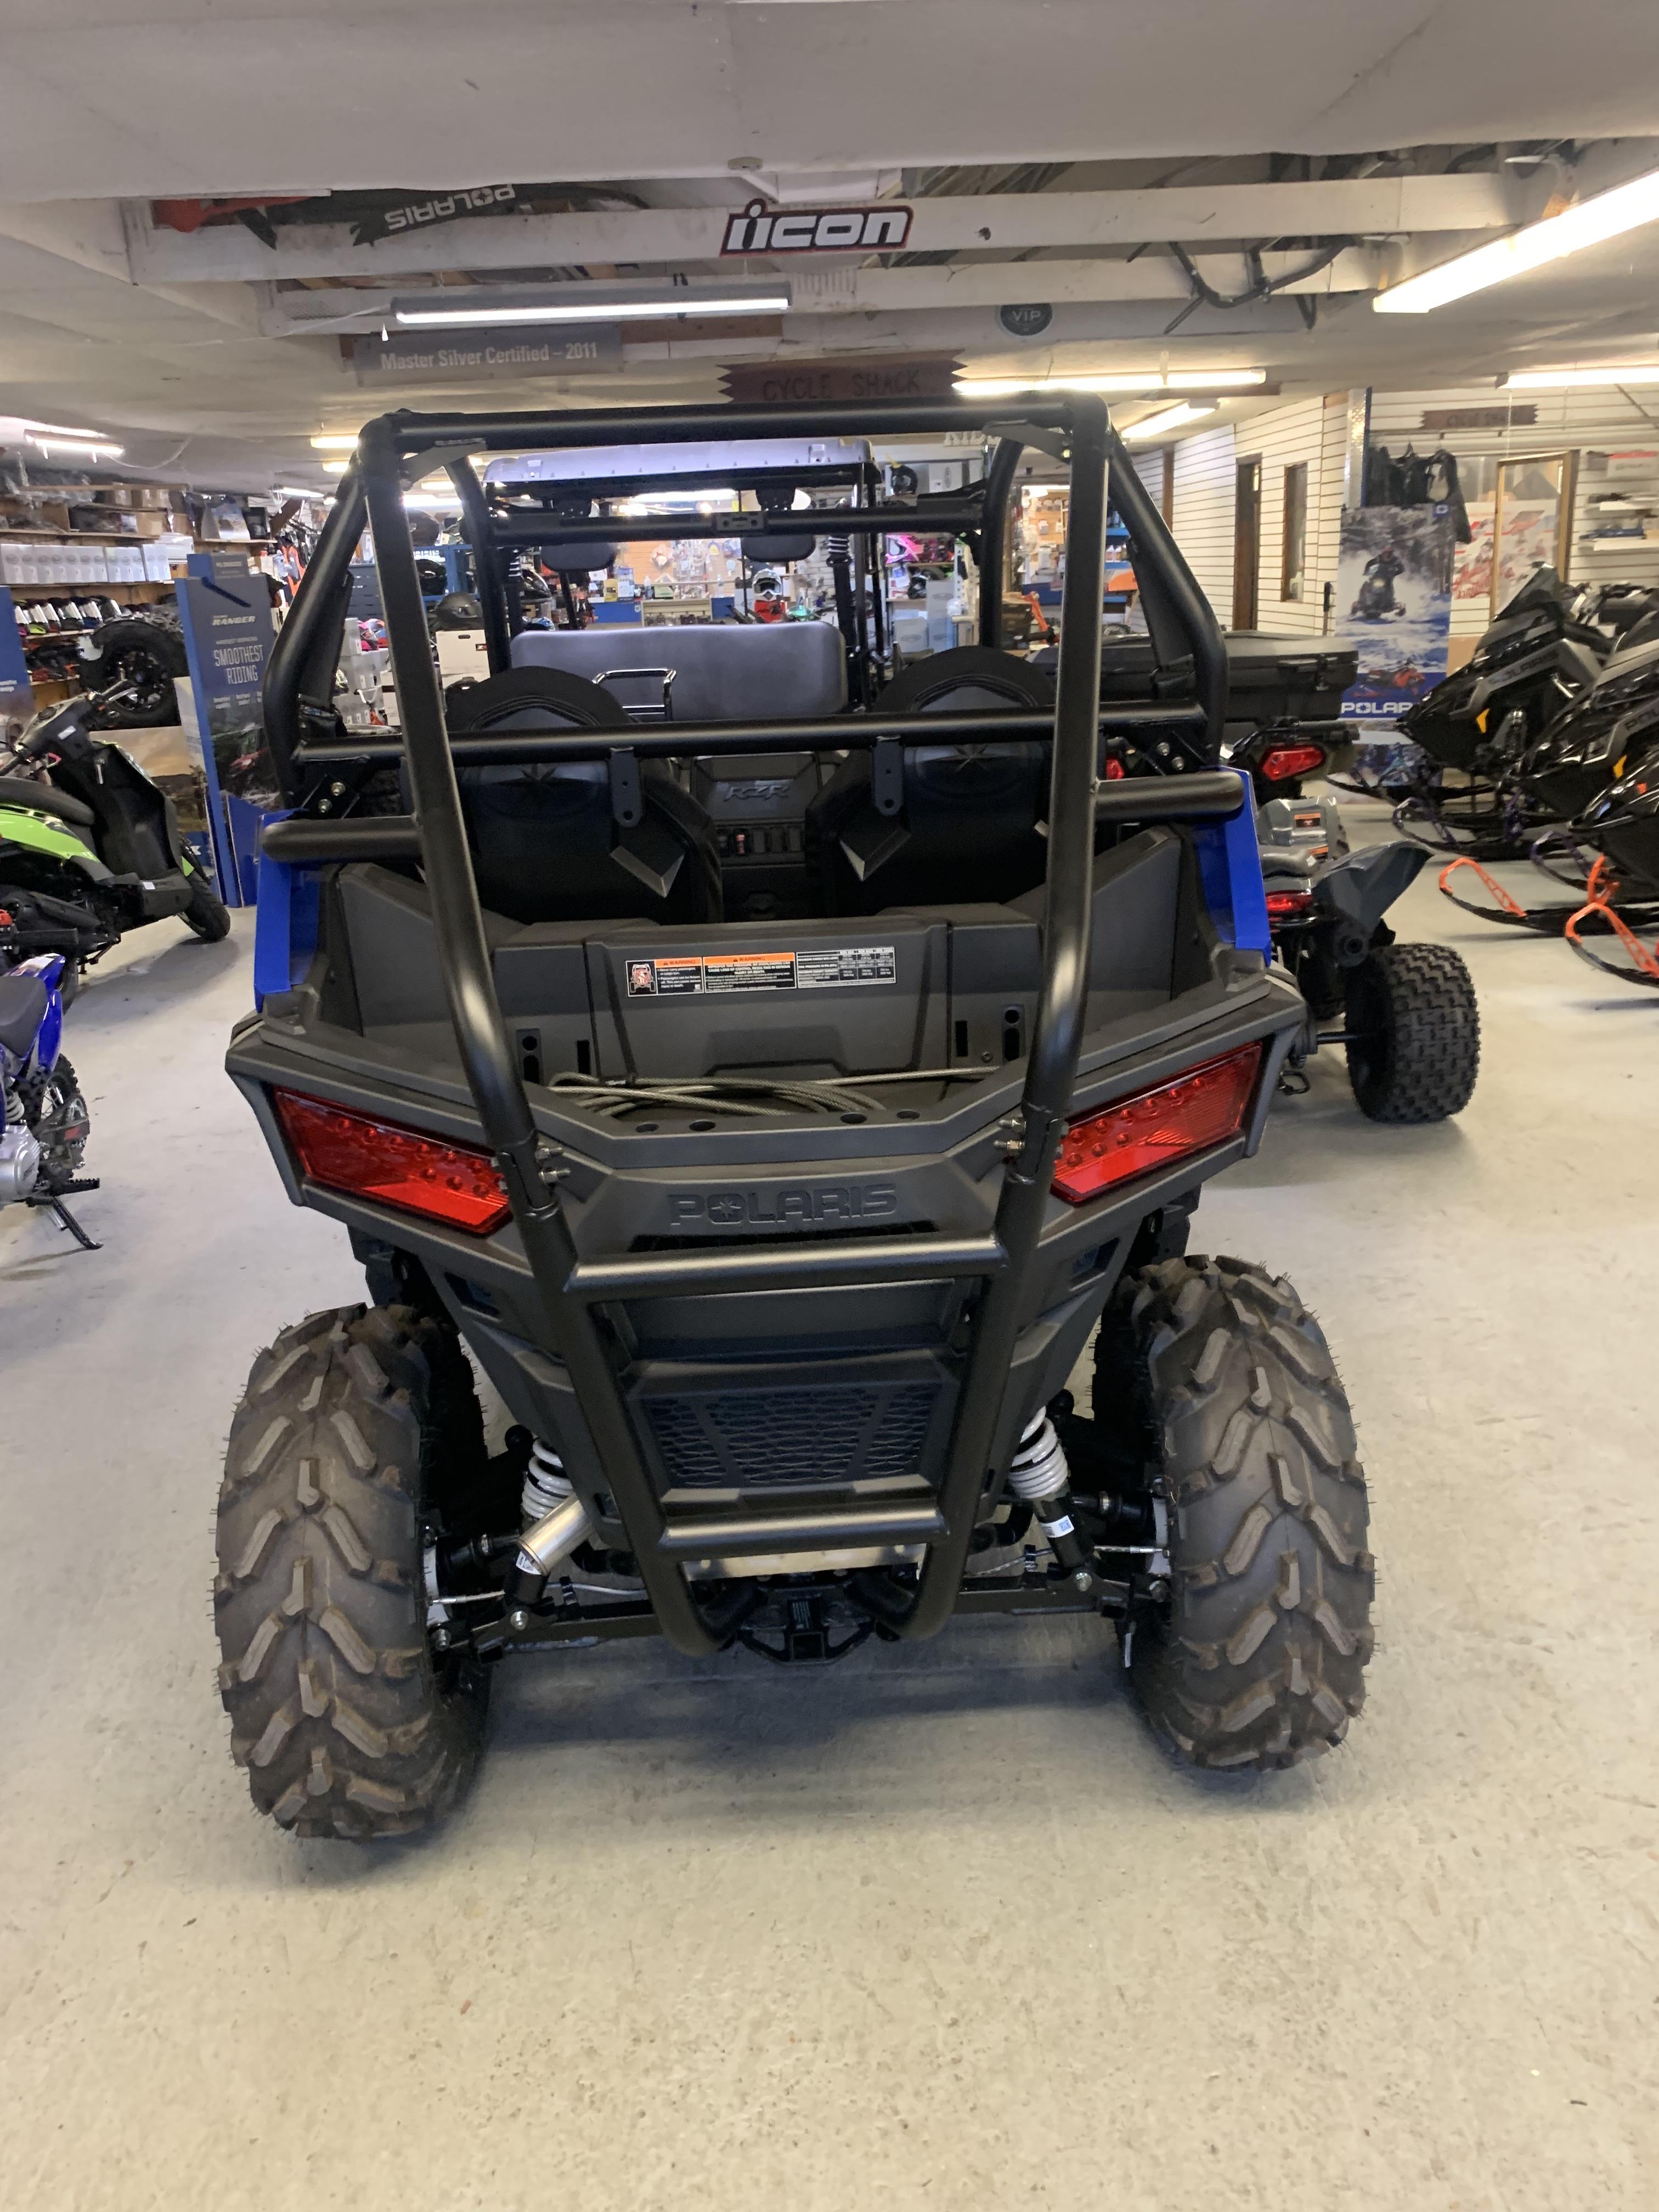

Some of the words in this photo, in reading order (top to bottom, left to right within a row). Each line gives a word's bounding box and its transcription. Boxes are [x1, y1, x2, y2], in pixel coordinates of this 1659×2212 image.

[385, 184, 516, 230] POLARIS
[1012, 311, 1041, 321] VIP
[380, 353, 434, 369] Master
[439, 349, 482, 366] Silver
[486, 344, 549, 364] Certified
[565, 342, 597, 360] 2011
[852, 369, 921, 397] SHACK
[213, 645, 263, 667] SMOOTHEST
[226, 664, 258, 685] RIDING
[1341, 702, 1413, 714] POLAR
[667, 1183, 897, 1226] POLARIS
